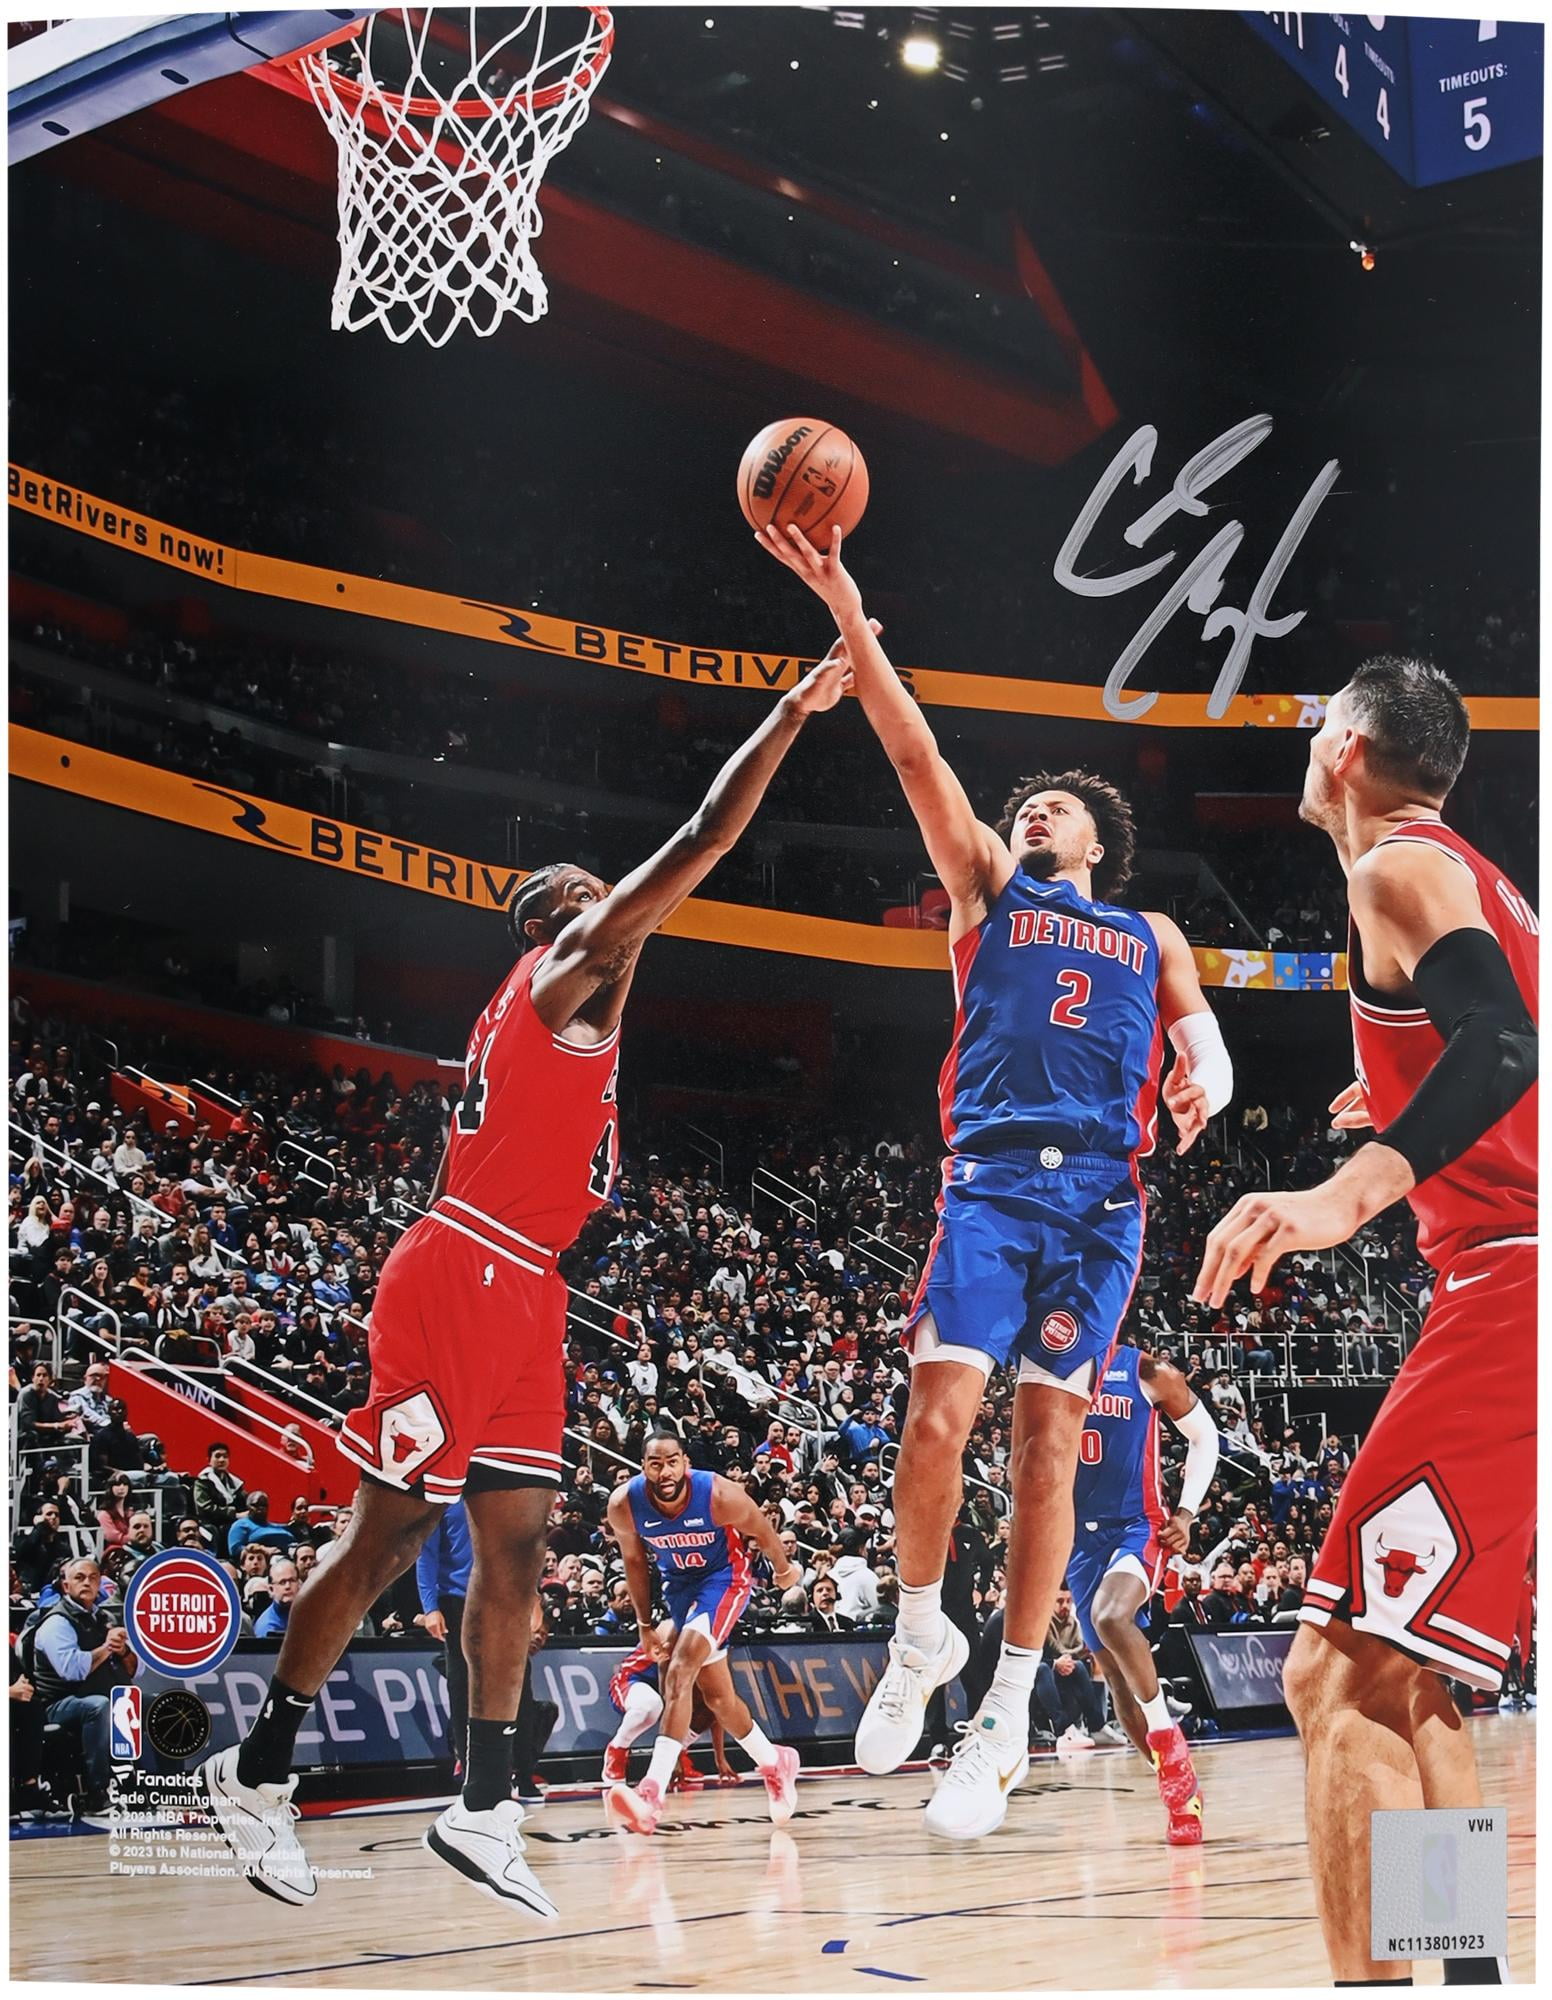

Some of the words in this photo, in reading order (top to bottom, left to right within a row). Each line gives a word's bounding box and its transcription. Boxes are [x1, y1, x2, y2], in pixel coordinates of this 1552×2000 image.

[1335, 44, 1349, 98] 4
[1439, 64, 1508, 93] TIMEOUTS:
[1376, 88, 1390, 140] 4
[1463, 96, 1491, 151] 5
[753, 426, 813, 499] Wilson
[8, 468, 147, 546] BetRivers
[160, 529, 224, 575] now!
[574, 625, 916, 697] BETRIVS
[311, 818, 520, 906] BETRIV
[1009, 909, 1149, 976] DETROIT
[1049, 968, 1092, 1029] 2
[1087, 1393, 1133, 1420] ROIT
[1080, 1428, 1102, 1465] 0
[672, 1552, 708, 1569] 14
[183, 1668, 367, 1744] FRE
[733, 1659, 843, 1720] THE
[1468, 1819, 1493, 1832] VVH
[1388, 1935, 1485, 1952] NC113801923
